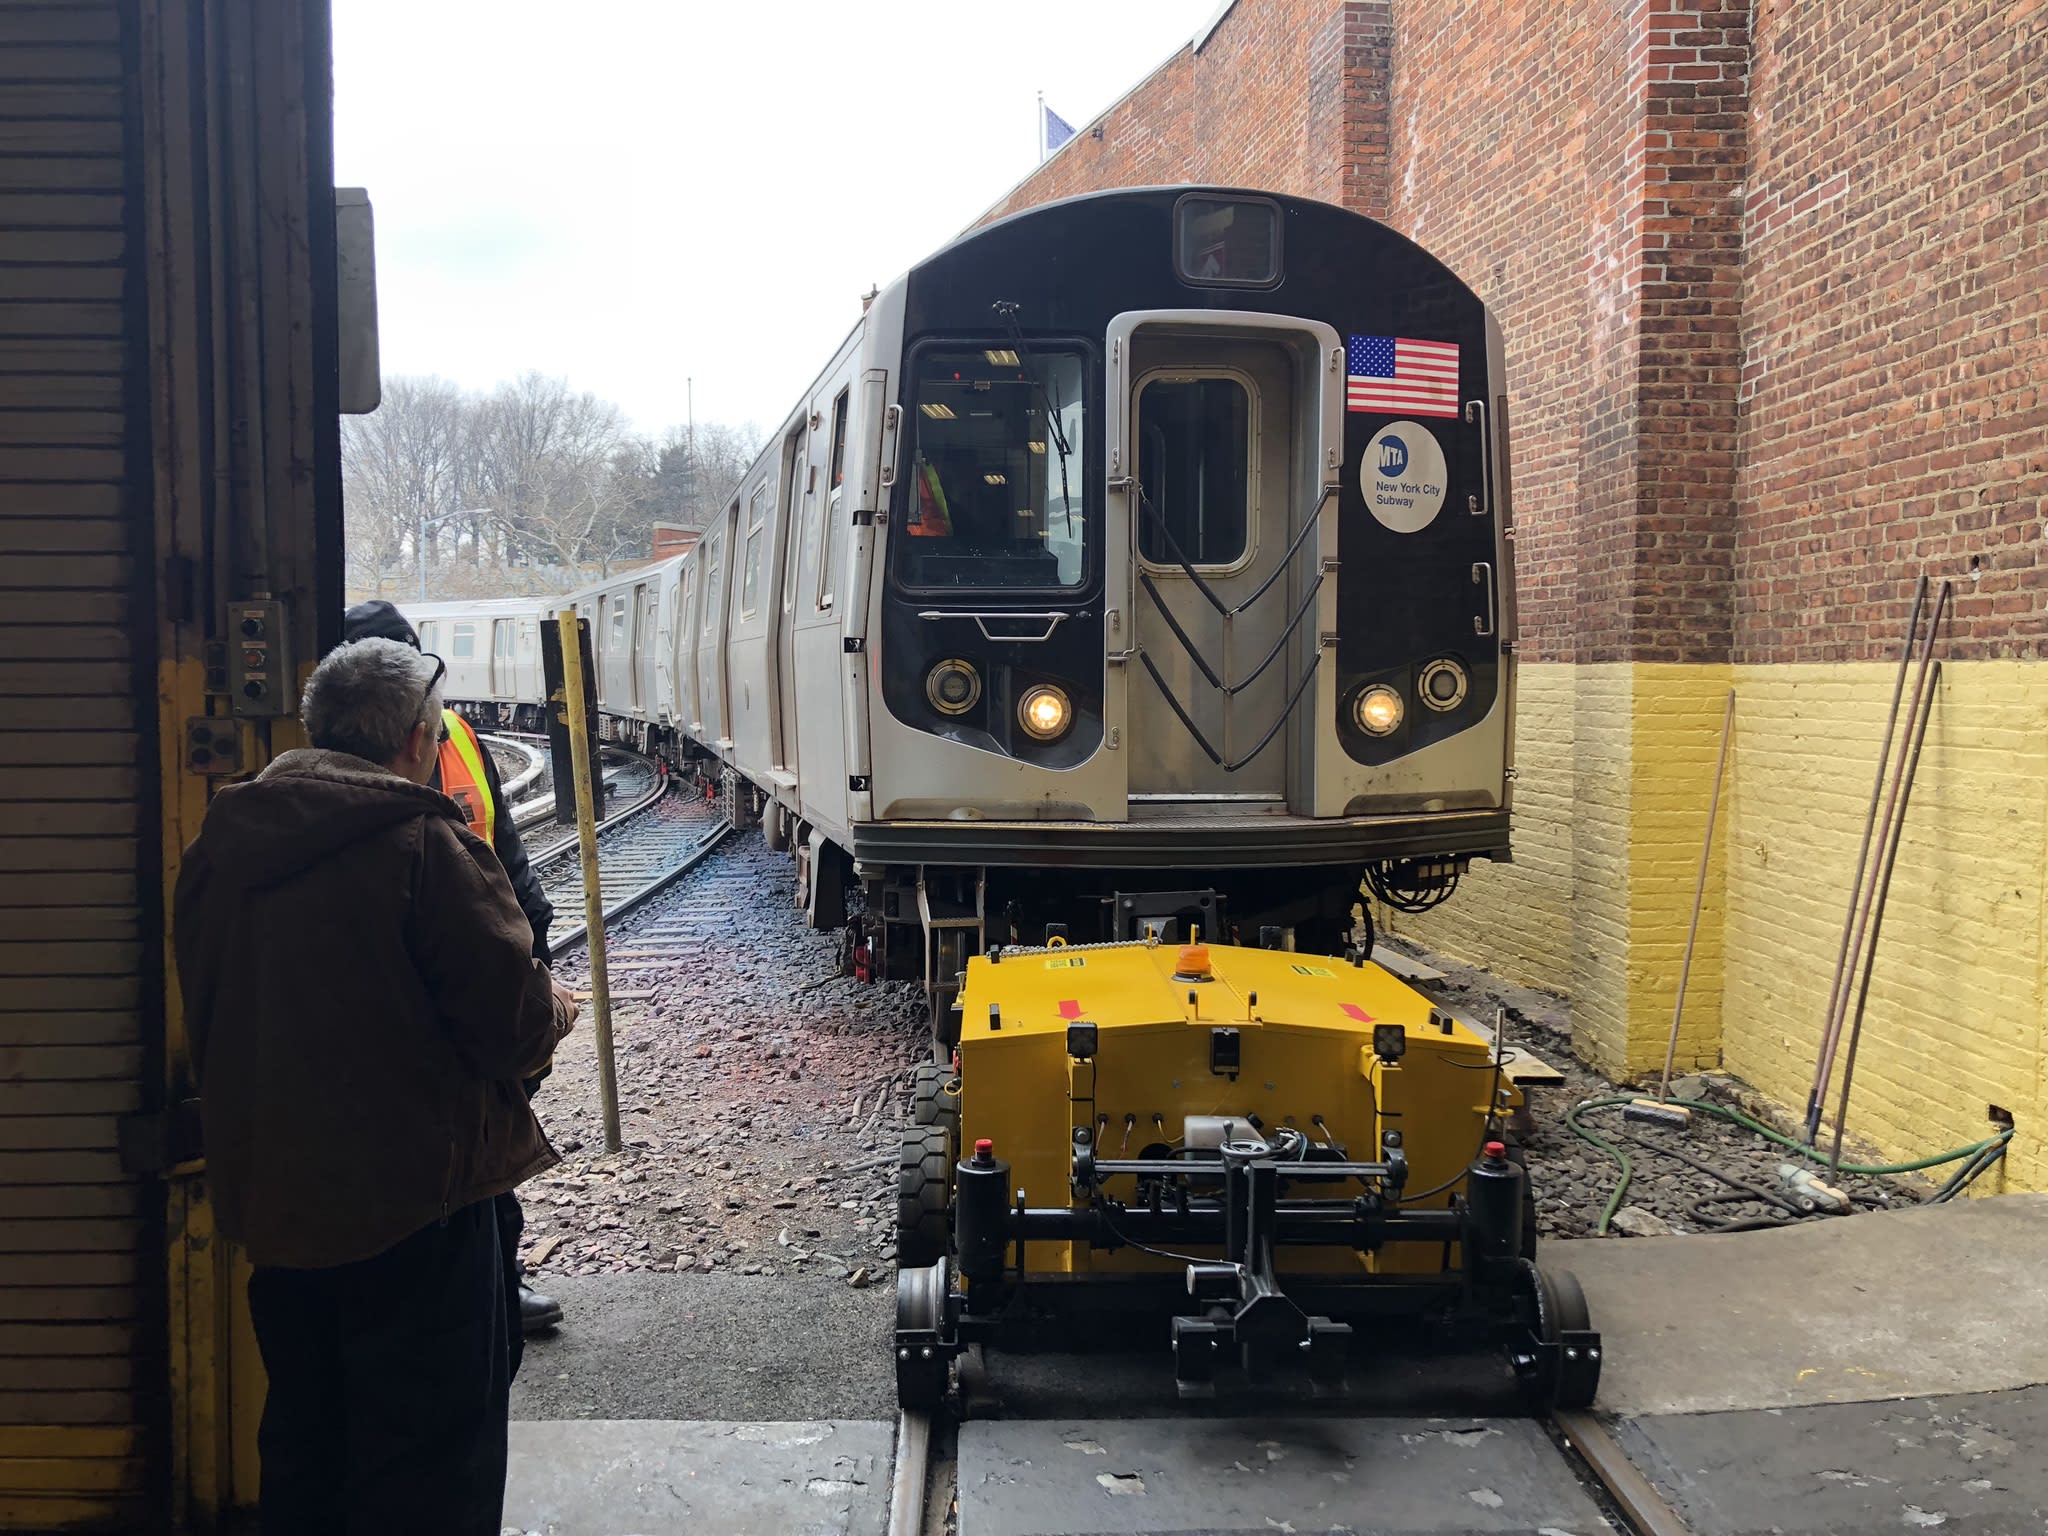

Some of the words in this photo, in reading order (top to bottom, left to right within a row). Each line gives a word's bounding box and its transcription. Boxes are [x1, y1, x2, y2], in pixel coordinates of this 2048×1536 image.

[1378, 444, 1403, 467] MTA
[1376, 481, 1398, 491] New
[1400, 483, 1420, 494] York
[1423, 484, 1440, 496] City
[1376, 494, 1414, 508] Subway
